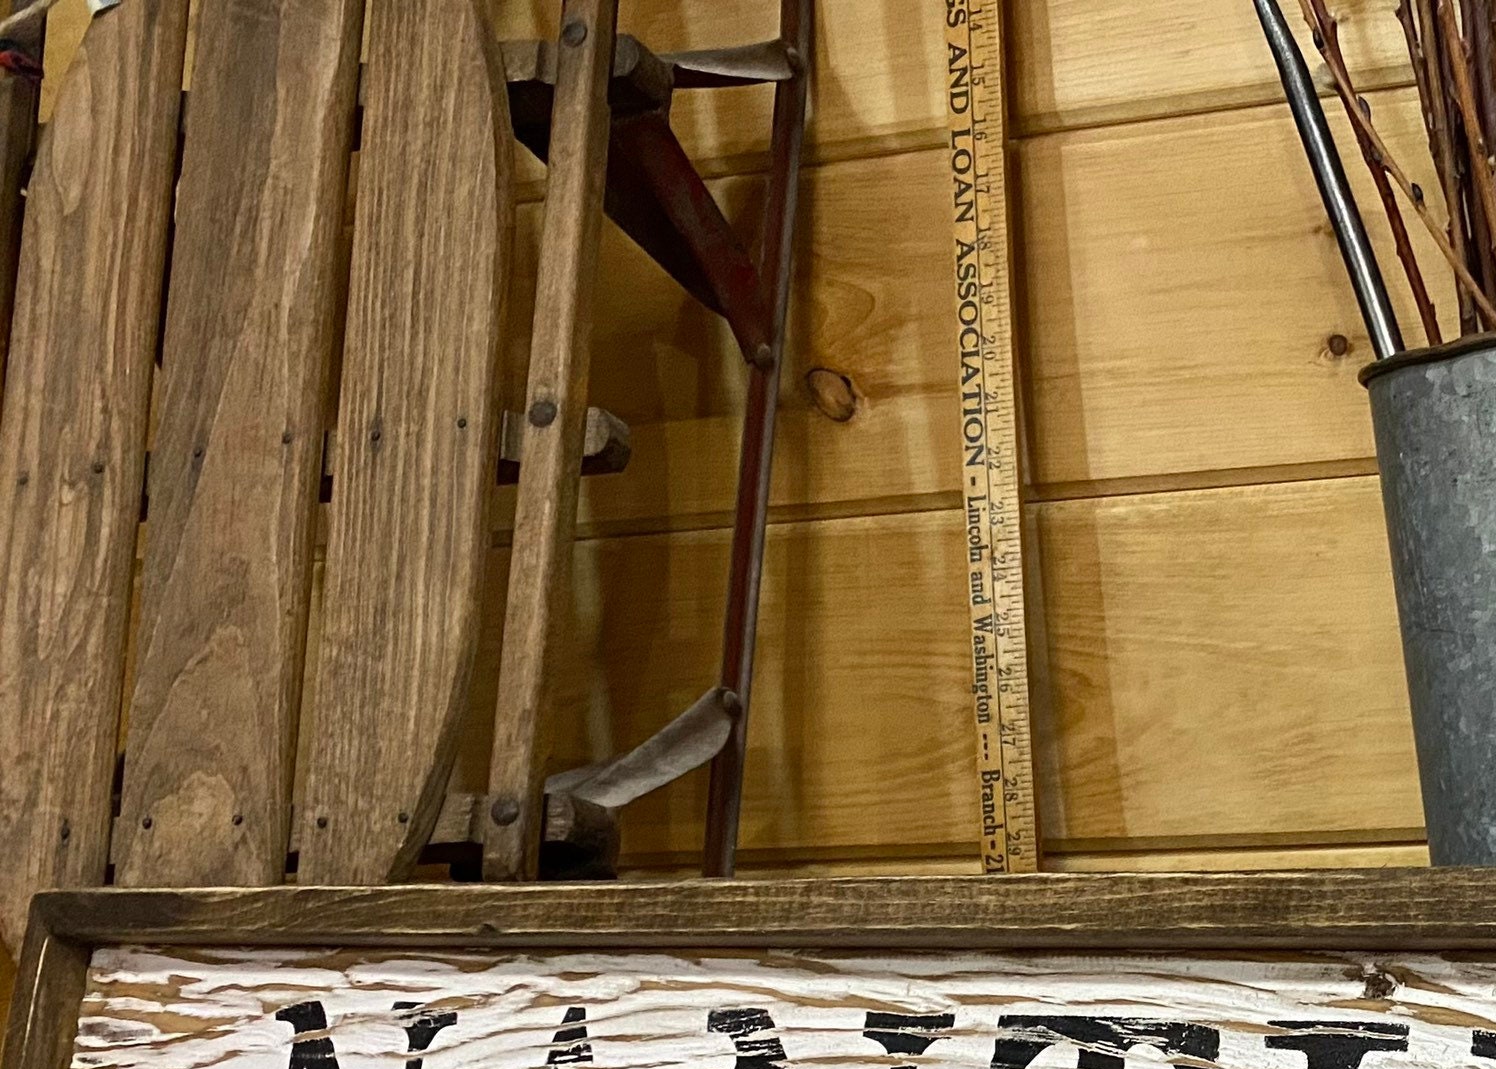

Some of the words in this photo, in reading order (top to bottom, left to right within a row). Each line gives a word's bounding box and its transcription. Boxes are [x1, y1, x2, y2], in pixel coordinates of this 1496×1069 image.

[948, 42, 969, 114] AND
[951, 128, 975, 223] LOAN
[955, 238, 985, 466] ASSOCIATION
[967, 494, 989, 563] Lincoln
[970, 571, 992, 606] and
[971, 612, 995, 724] Washington
[981, 769, 1004, 836] Branch
